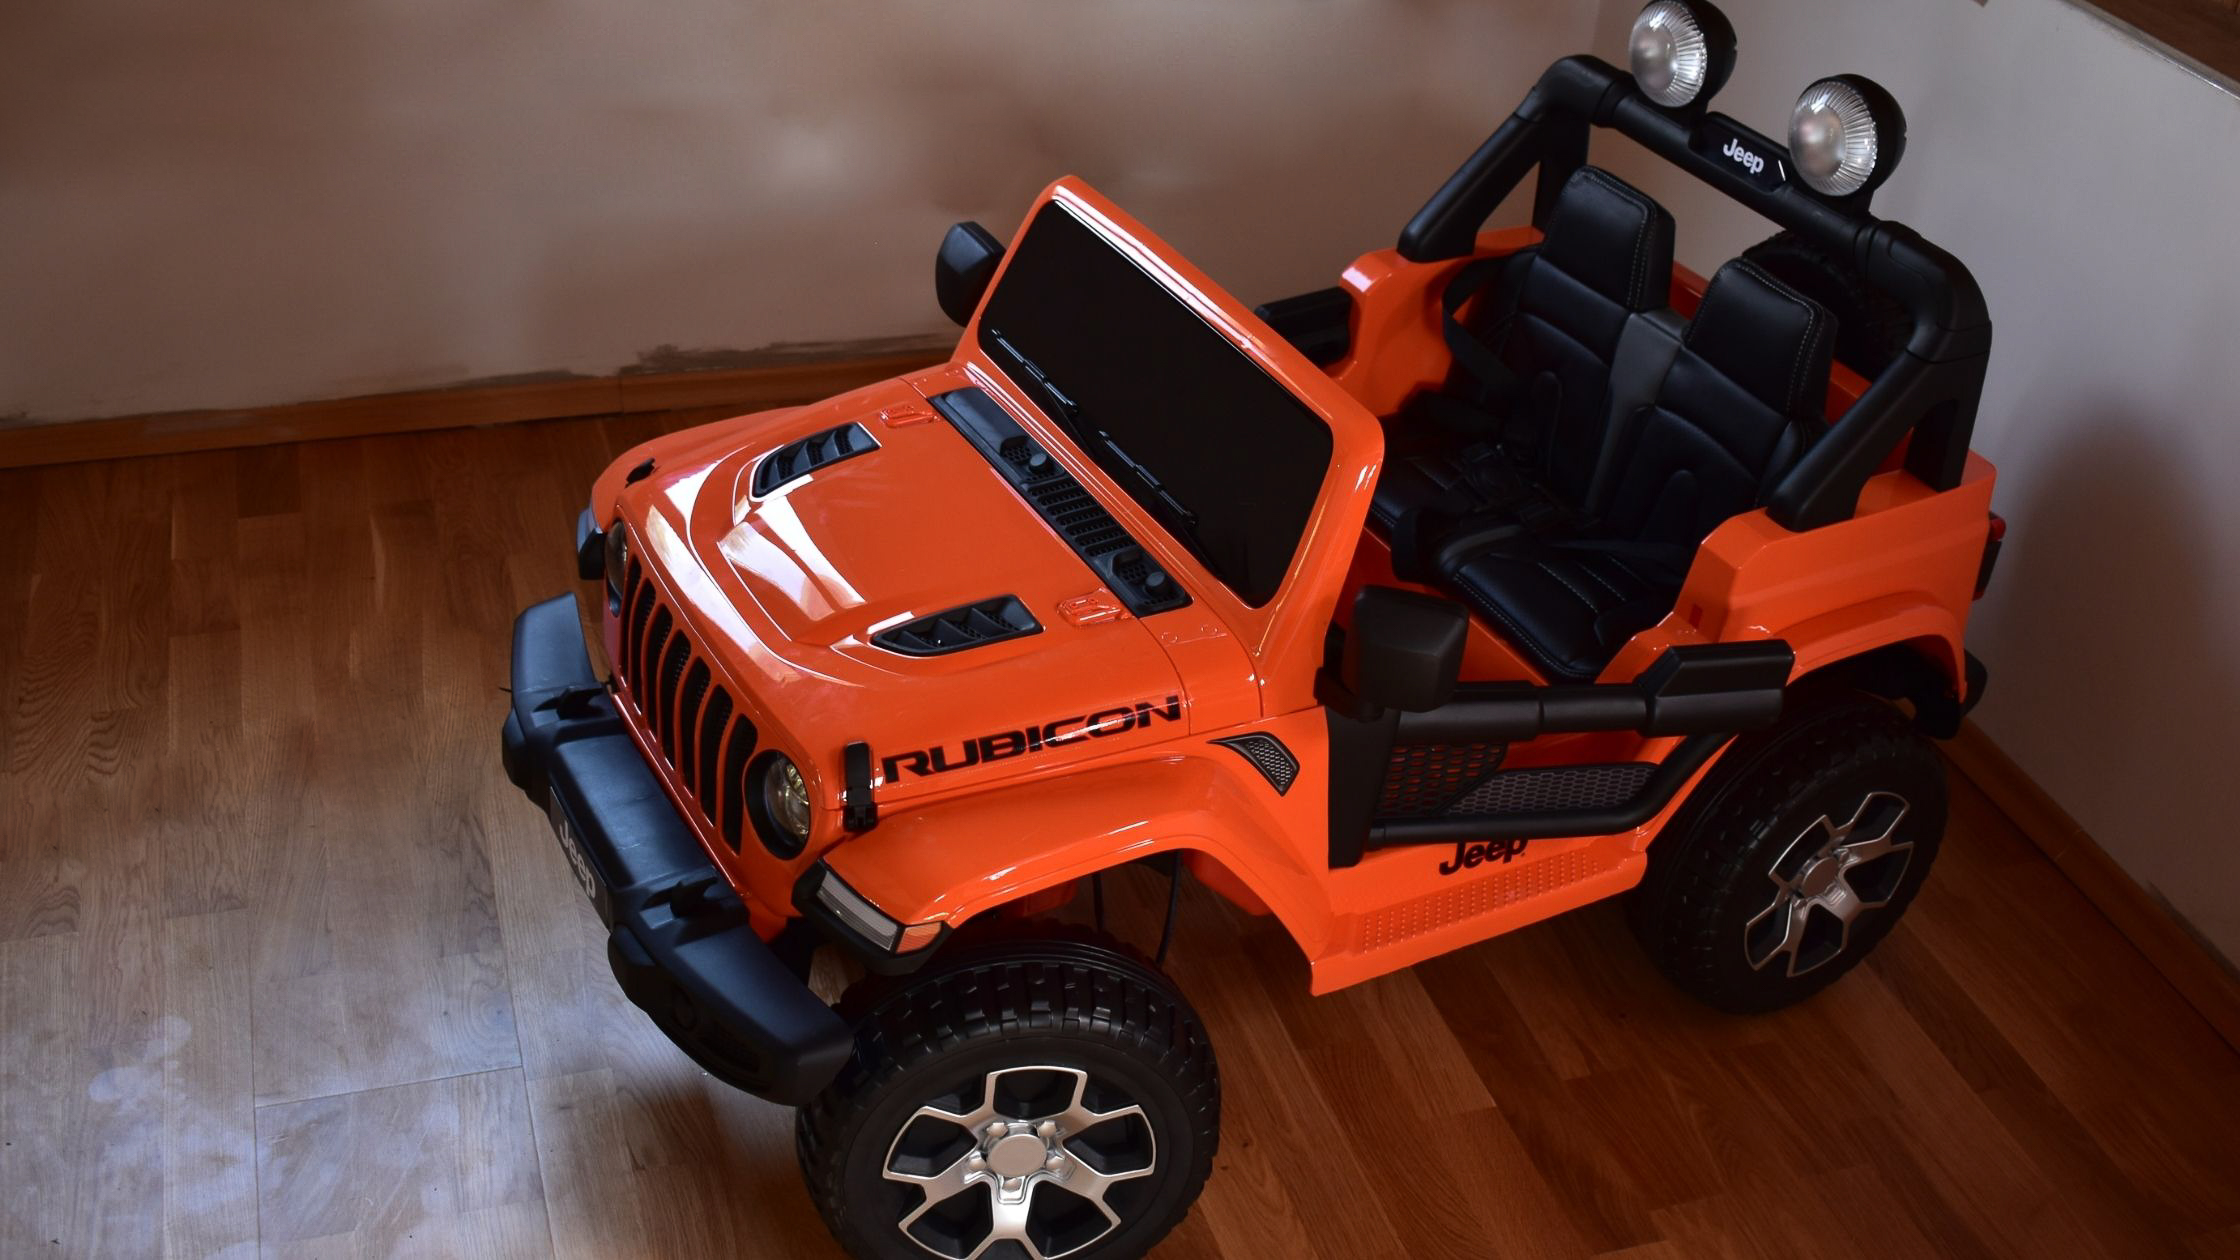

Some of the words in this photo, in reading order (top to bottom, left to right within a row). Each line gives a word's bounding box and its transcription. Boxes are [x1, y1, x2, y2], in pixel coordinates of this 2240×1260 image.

[1723, 138, 1764, 174] Jeep
[881, 695, 1181, 784] RUBICON
[559, 819, 595, 898] Jeep
[1438, 839, 1529, 875] Jeep
